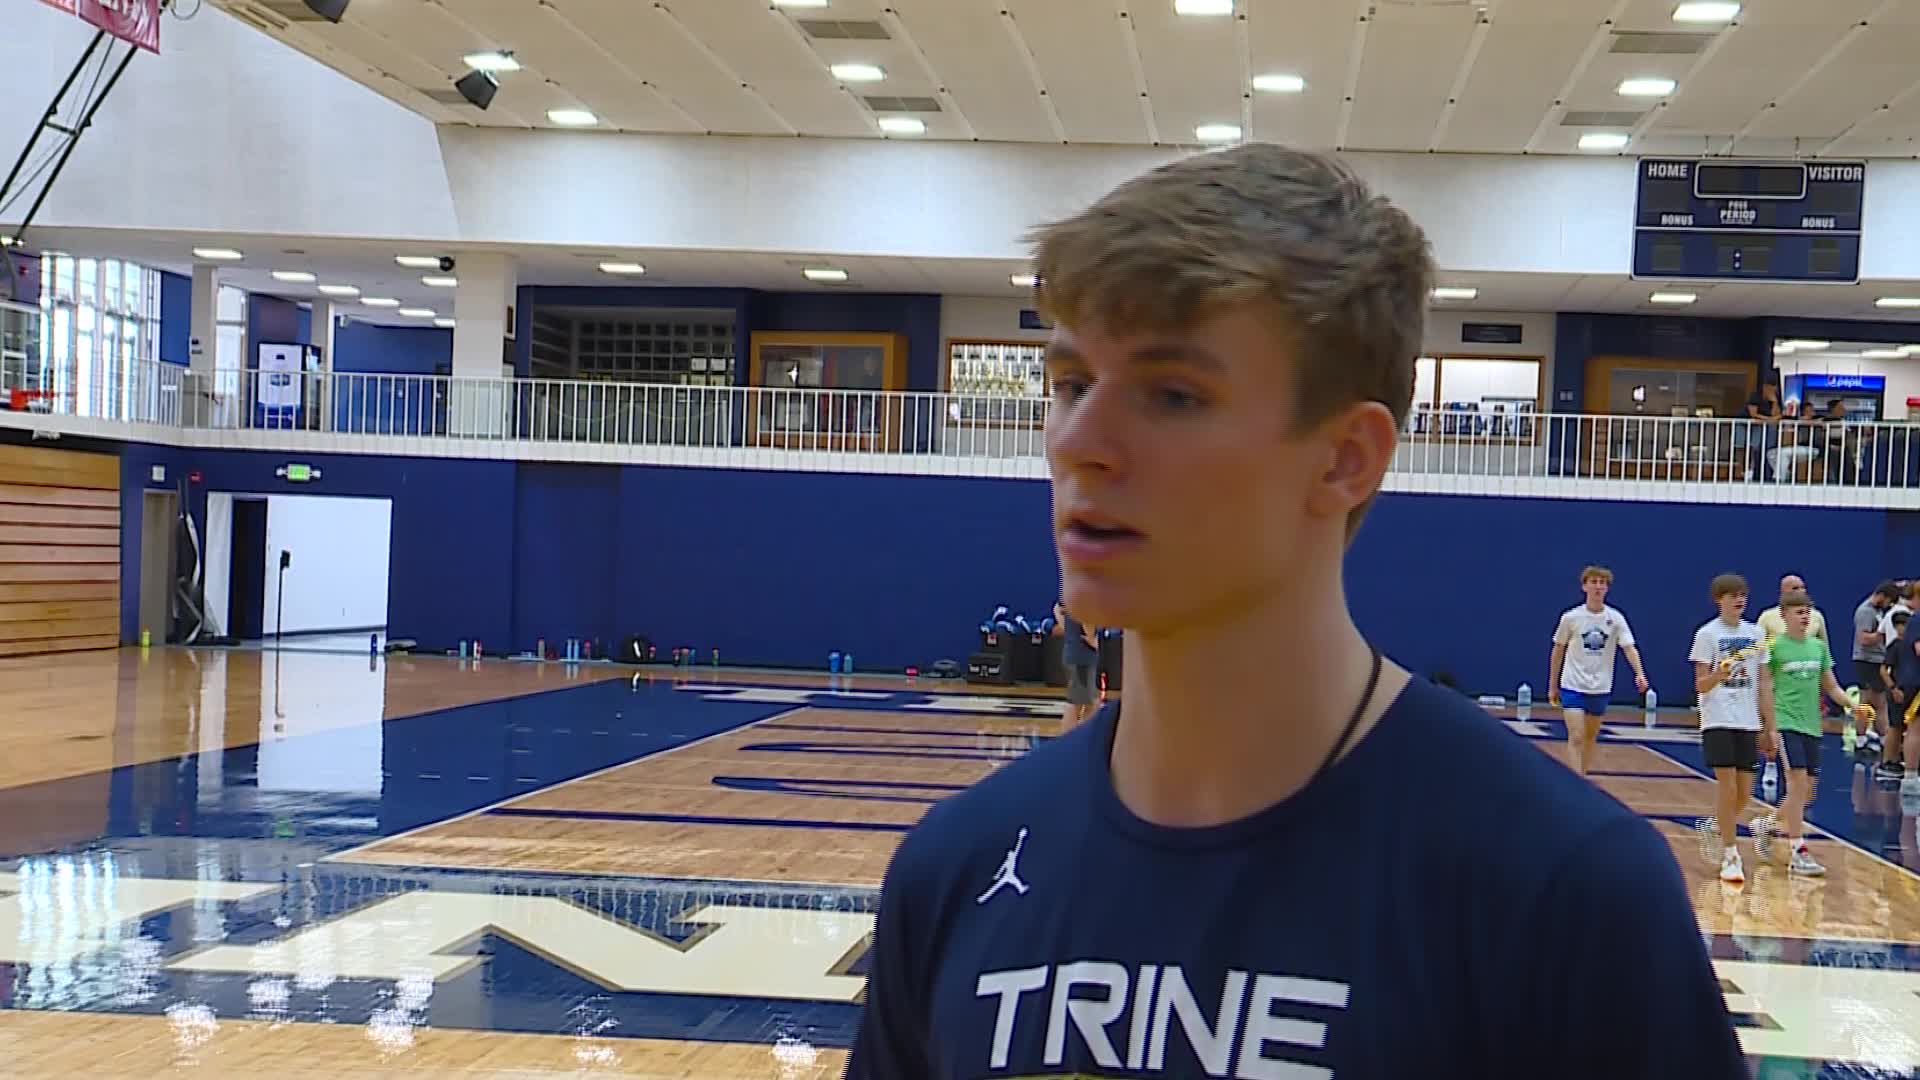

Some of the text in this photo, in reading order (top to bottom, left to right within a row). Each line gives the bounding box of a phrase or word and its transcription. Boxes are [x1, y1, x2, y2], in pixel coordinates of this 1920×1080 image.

[1648, 163, 1688, 177] HOME
[1808, 166, 1863, 181] VISITOR
[1661, 214, 1694, 226] BONUS
[1720, 209, 1756, 219] PERIOD
[1802, 217, 1836, 229] BONUS
[1837, 375, 1862, 388] pepsi
[975, 960, 1352, 1080] TRINE
